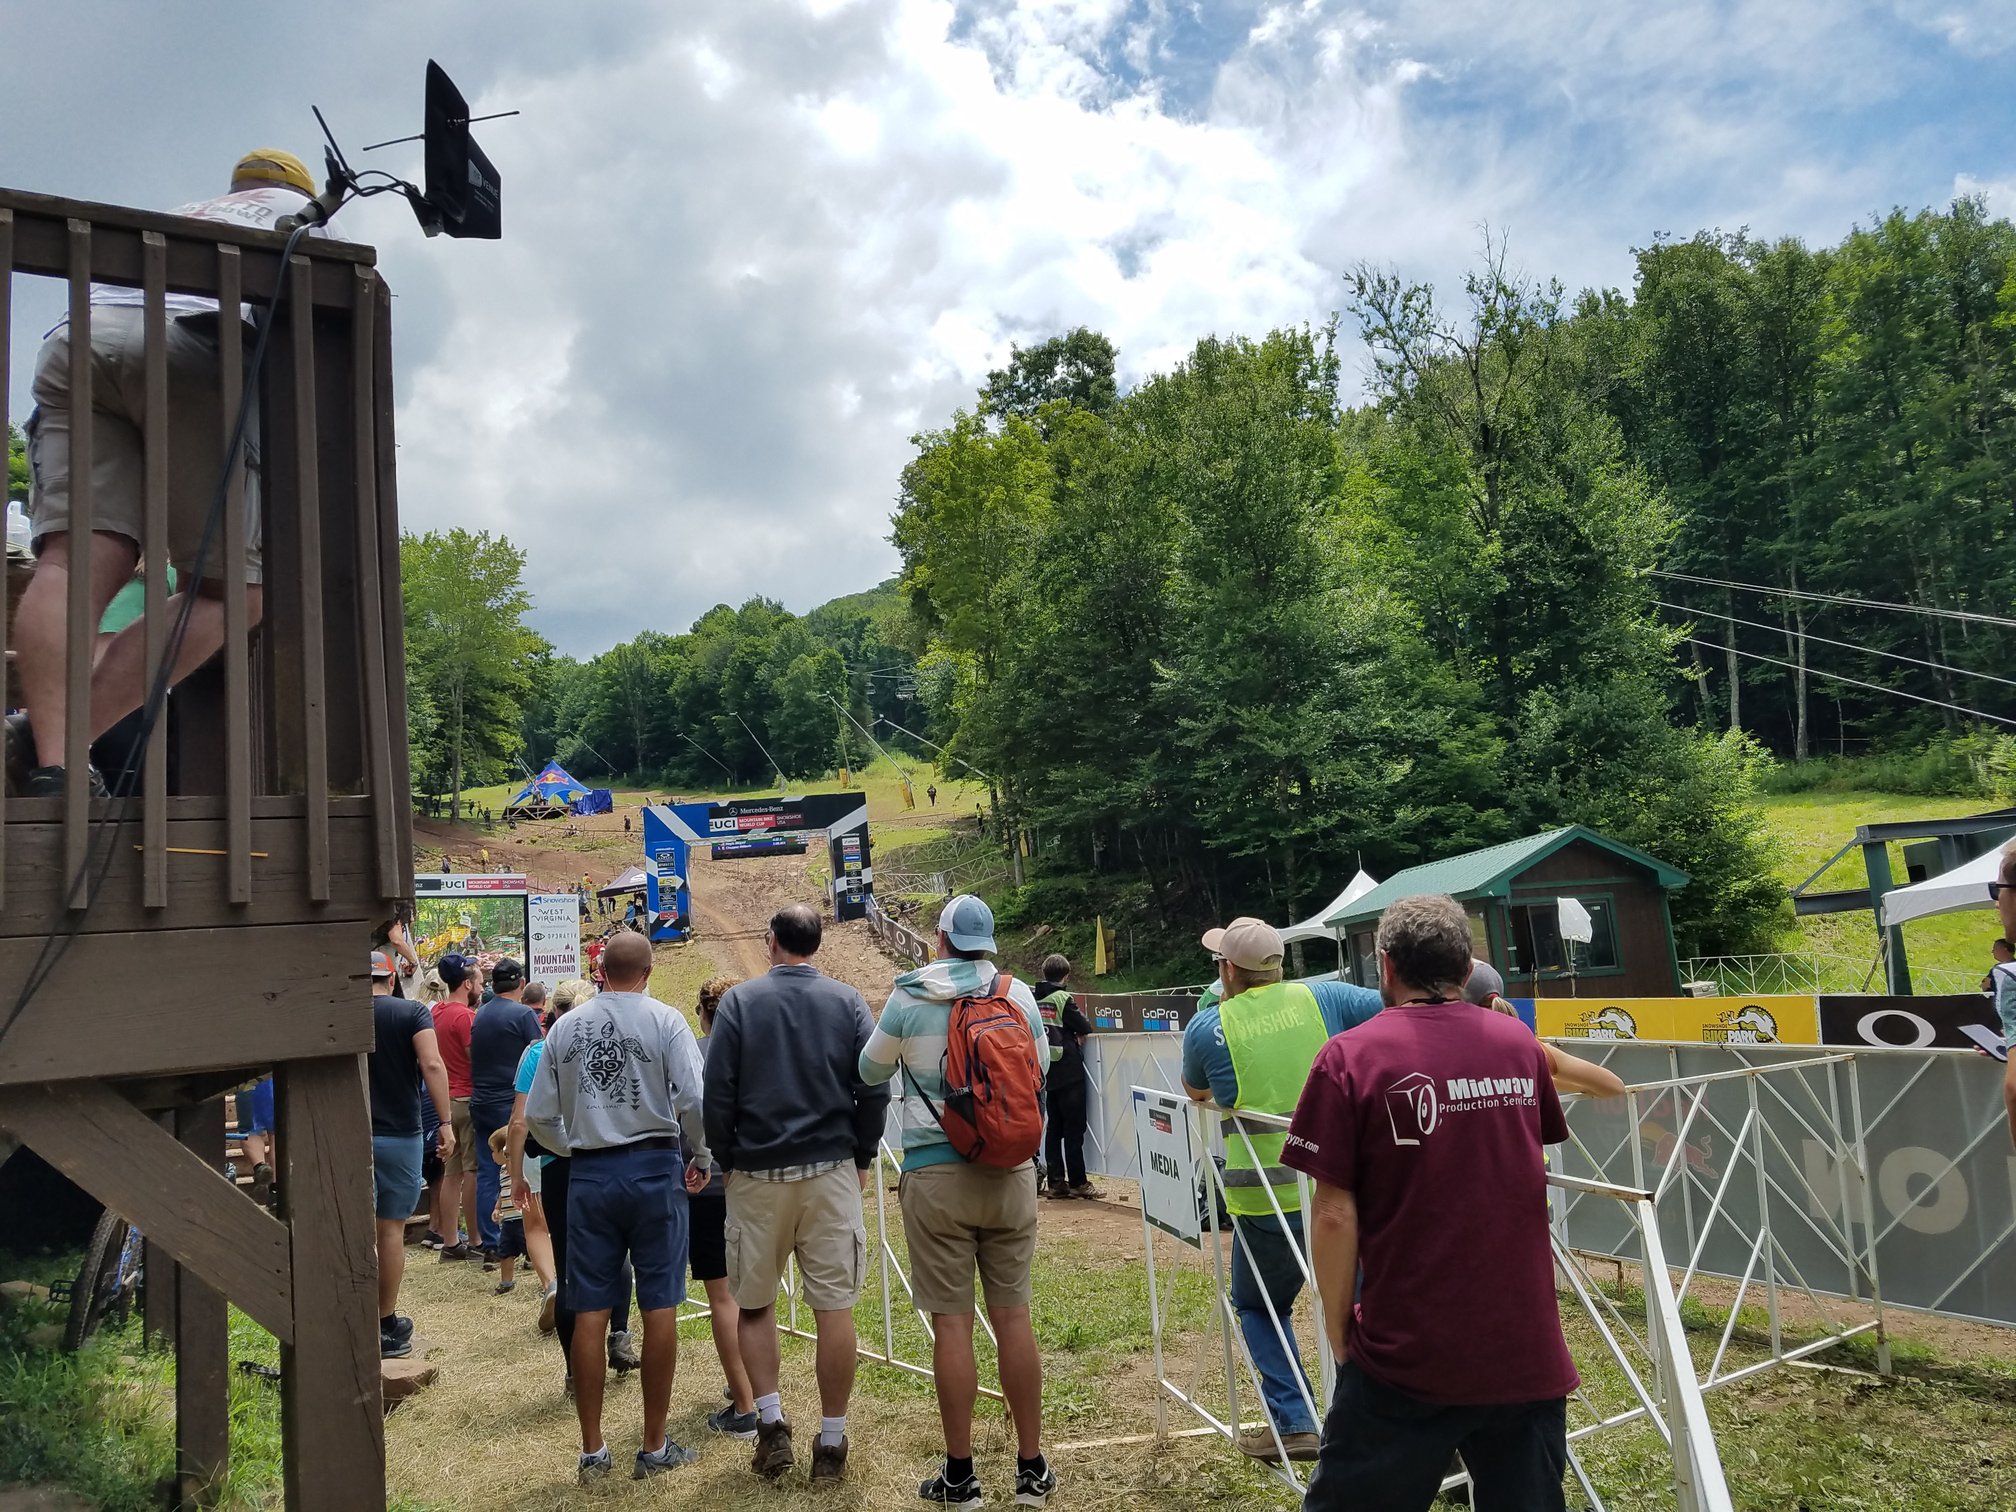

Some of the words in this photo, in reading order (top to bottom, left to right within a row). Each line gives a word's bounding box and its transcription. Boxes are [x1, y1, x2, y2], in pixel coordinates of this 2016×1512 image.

[740, 805, 784, 815] Mercedes-Benz
[714, 819, 736, 829] UCI
[446, 880, 465, 889] UCI
[531, 915, 576, 924] VIRGINIA
[533, 954, 576, 965] MOUNTAIN
[533, 965, 576, 975] PLAYGROUND
[1094, 1006, 1122, 1018] GoPro
[1142, 1007, 1179, 1019] GoPro
[1446, 1077, 1534, 1101] Midway
[1439, 1098, 1500, 1114] Production
[1503, 1095, 1537, 1107] Services
[1150, 1150, 1181, 1182] MEDIA
